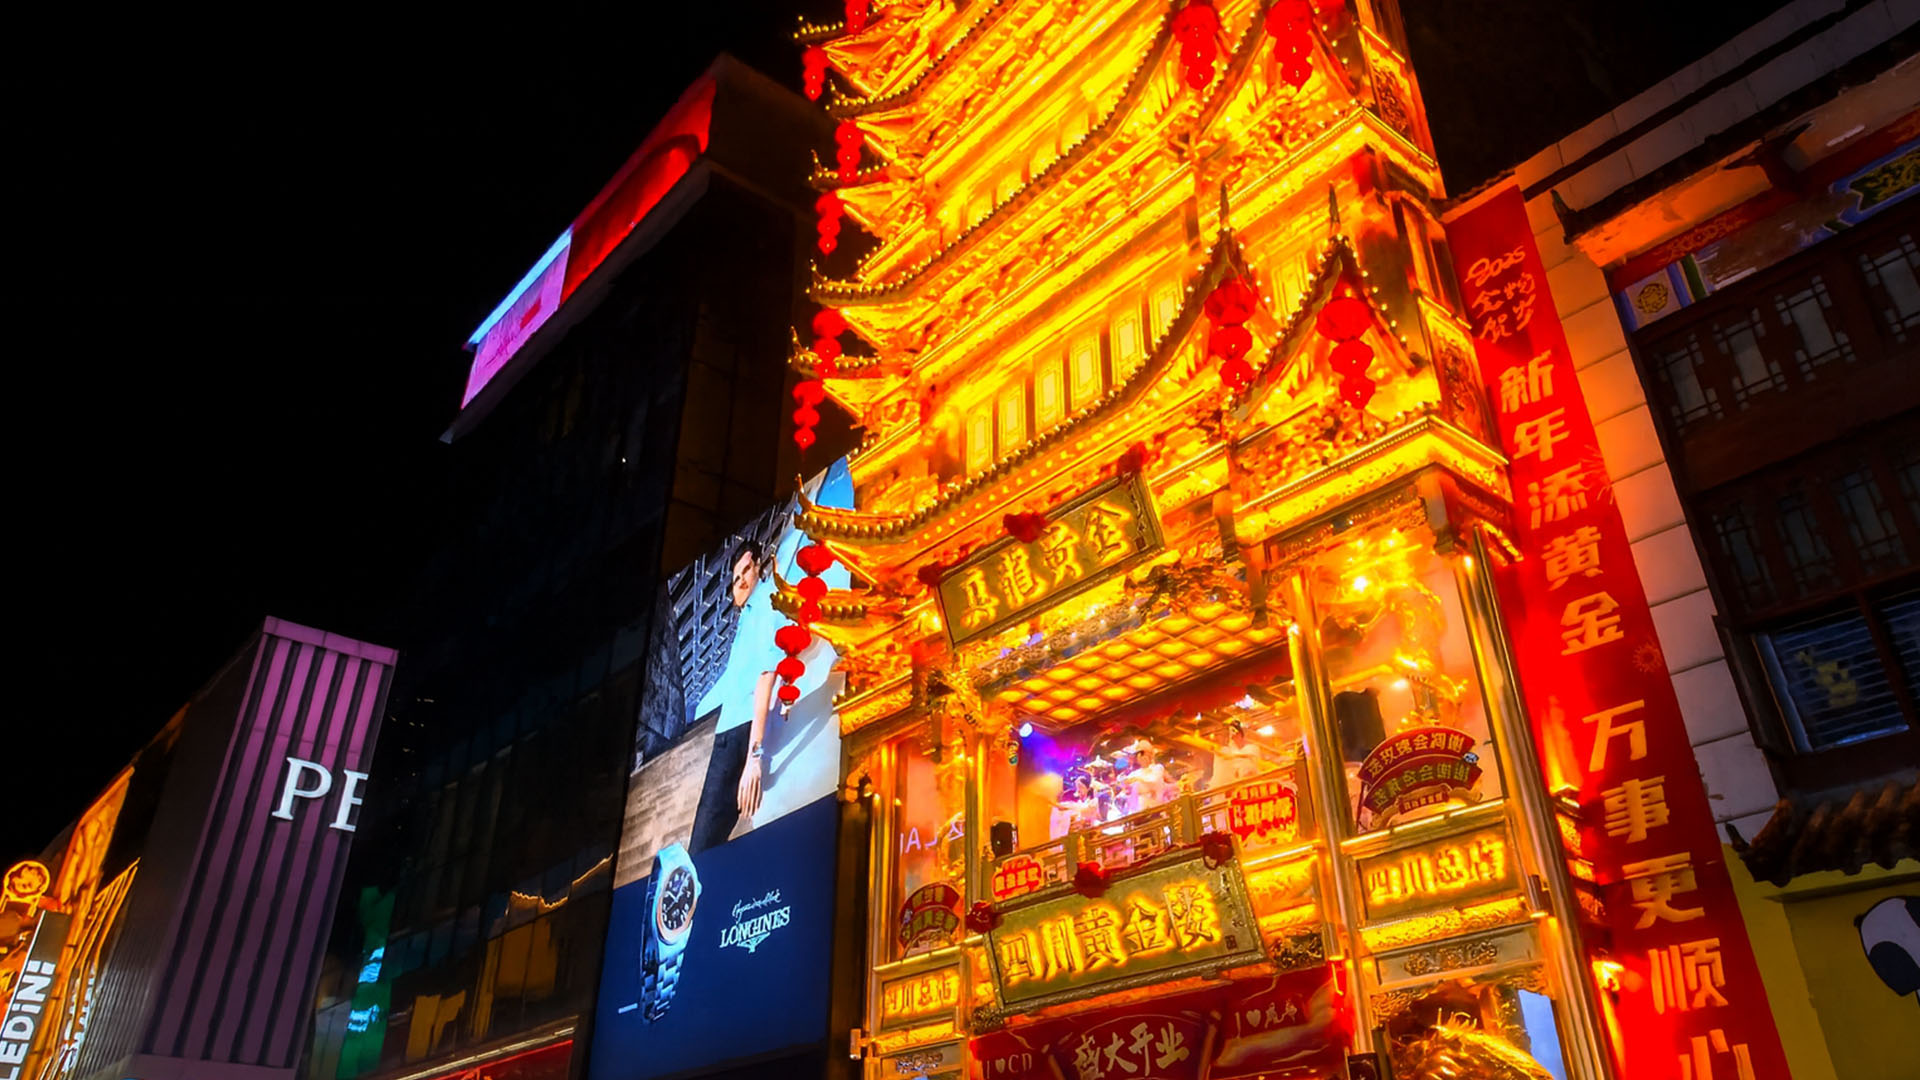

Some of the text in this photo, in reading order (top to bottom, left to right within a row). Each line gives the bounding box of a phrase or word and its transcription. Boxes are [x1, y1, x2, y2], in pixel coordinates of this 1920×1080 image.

[1498, 350, 1625, 657] 新年添黄金
[719, 906, 791, 948] LONGINES
[1072, 1022, 1191, 1080] 盛大开业
